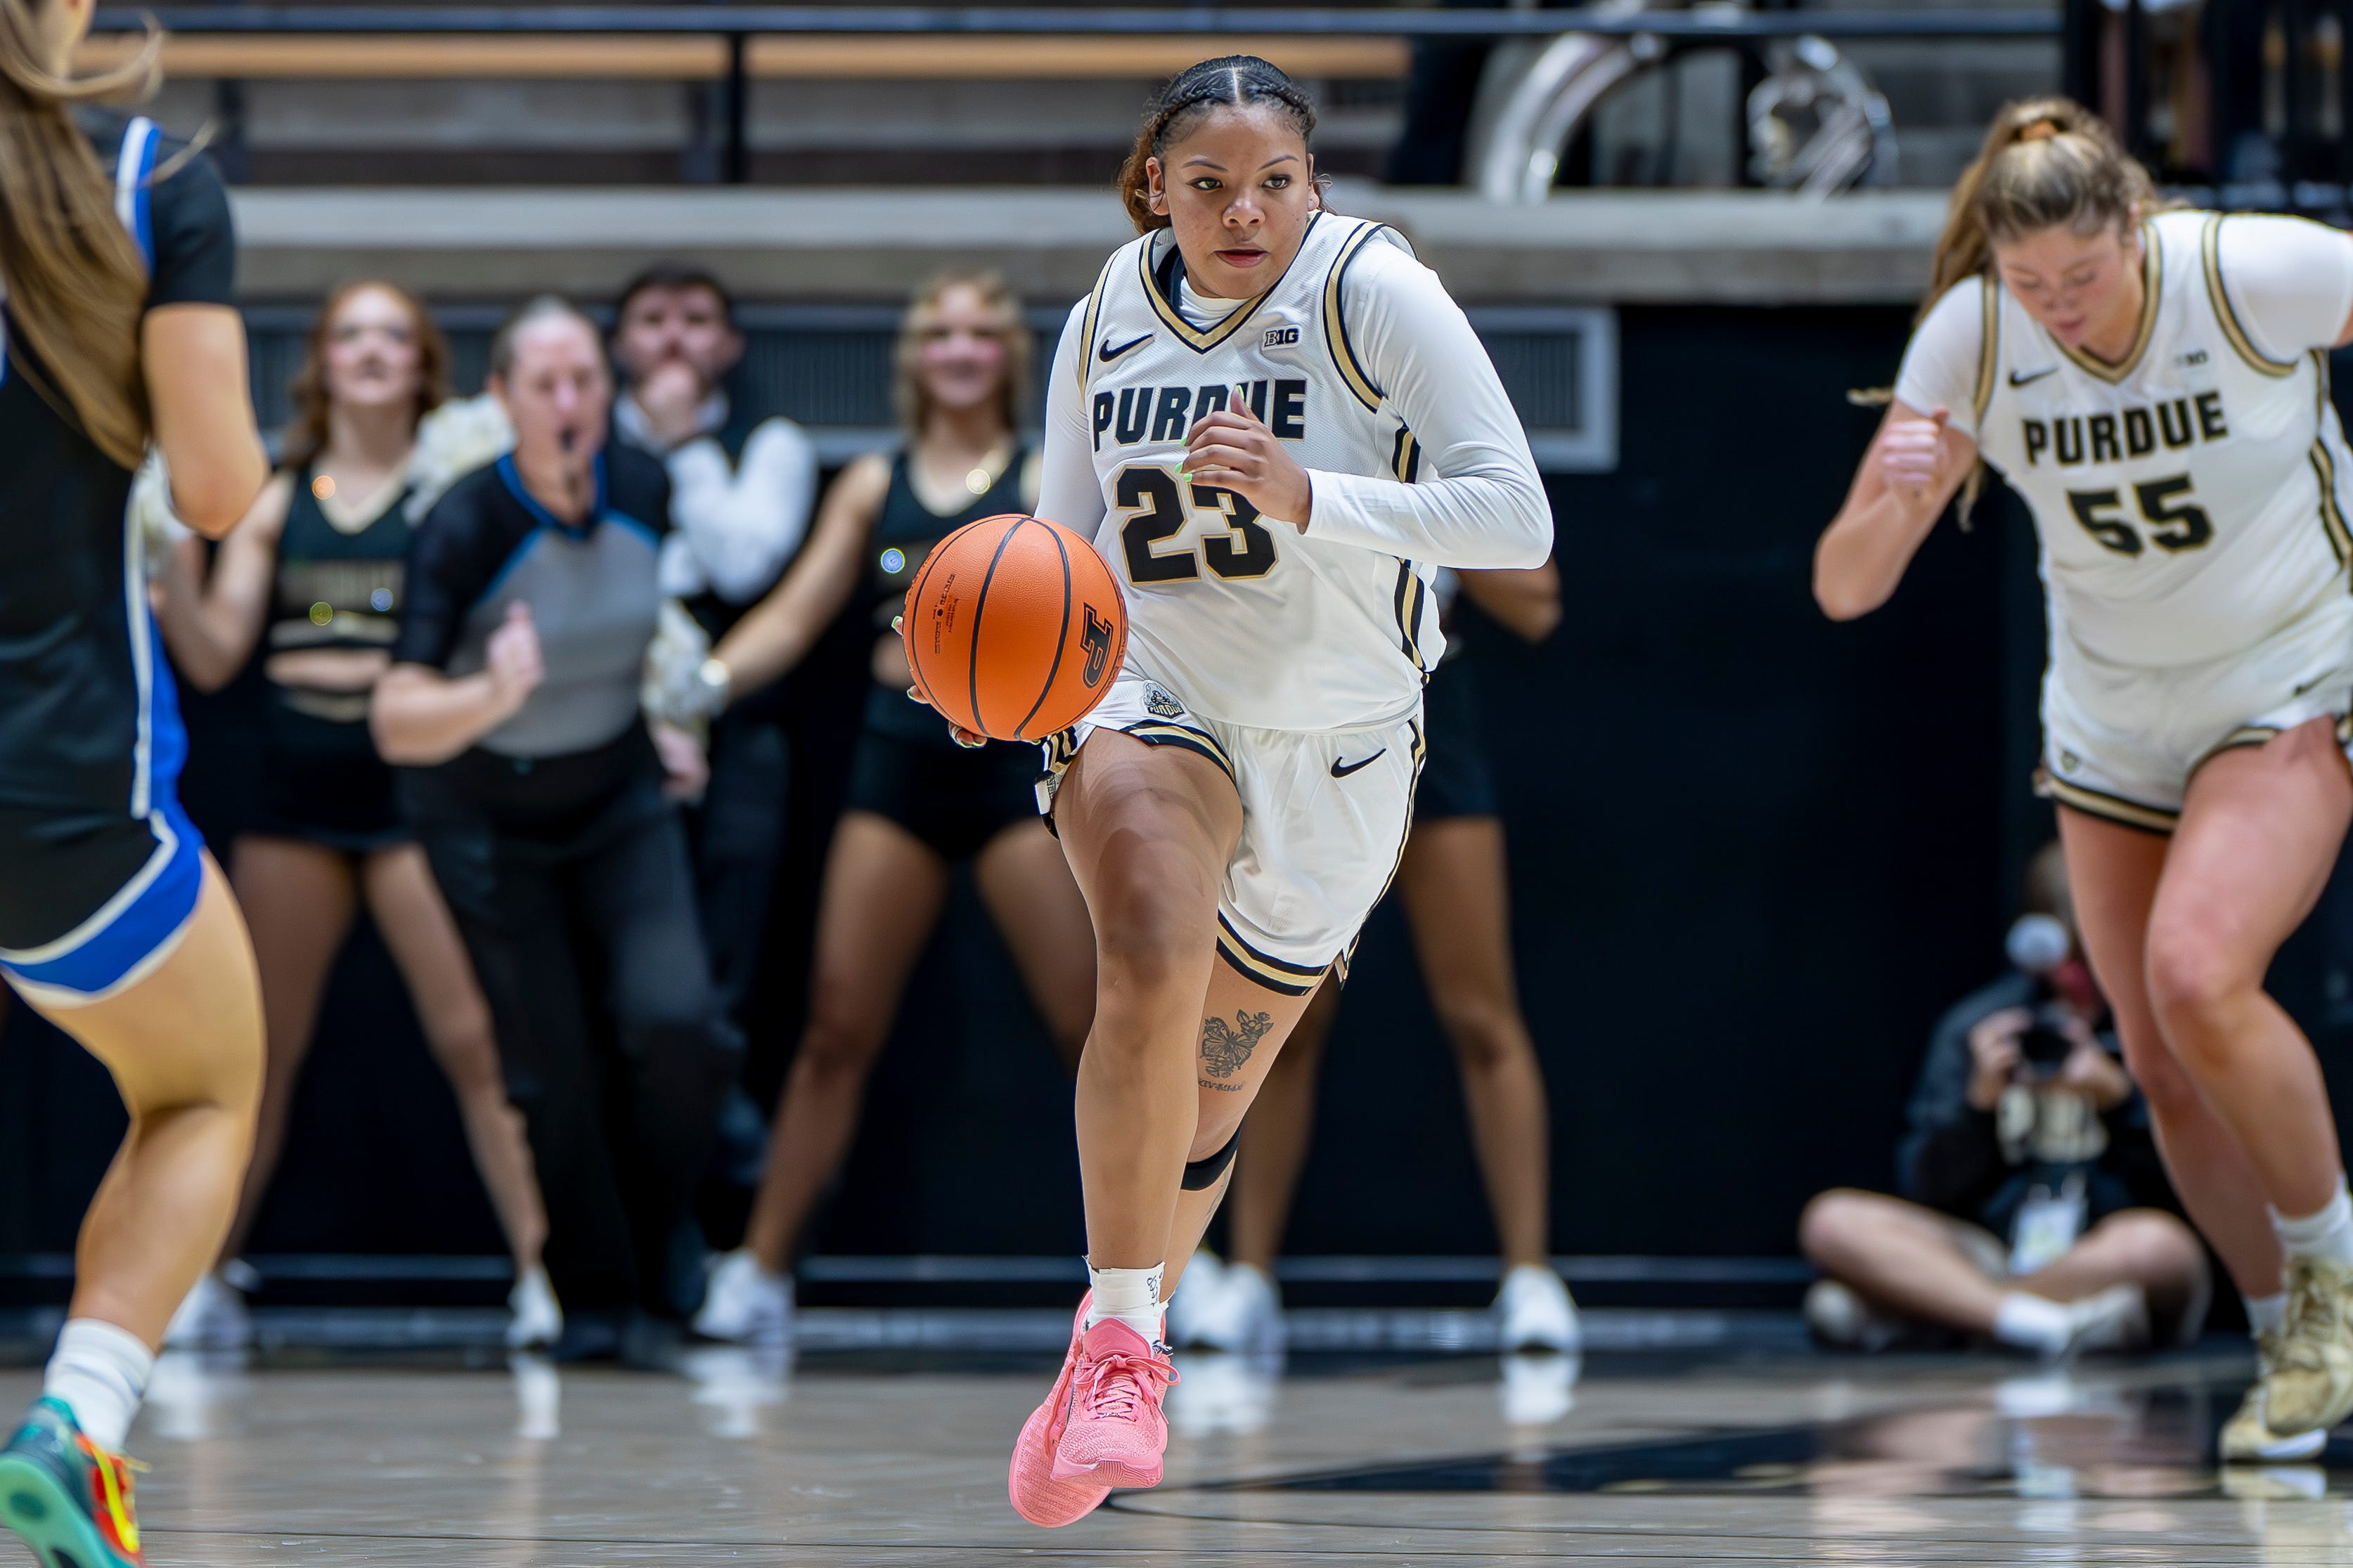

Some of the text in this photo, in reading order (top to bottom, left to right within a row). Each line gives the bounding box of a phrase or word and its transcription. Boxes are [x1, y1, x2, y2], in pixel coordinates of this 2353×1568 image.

[2022, 389, 2229, 467] PURDUE
[1115, 464, 1279, 585] 23
[2064, 470, 2215, 559] 55
